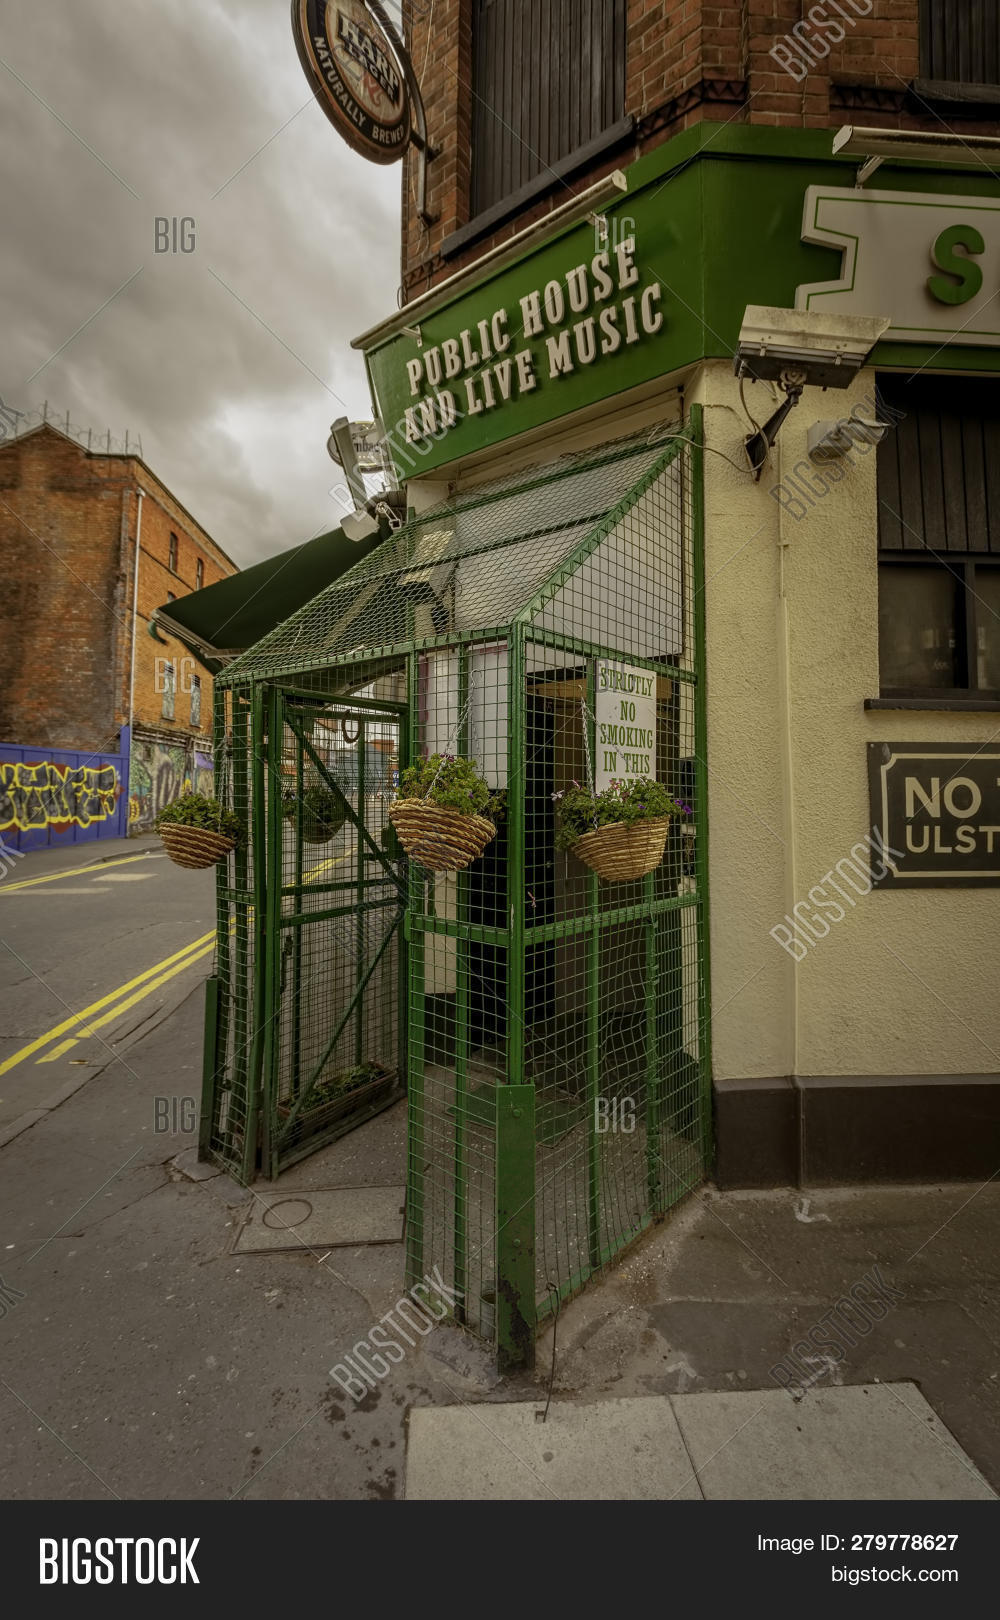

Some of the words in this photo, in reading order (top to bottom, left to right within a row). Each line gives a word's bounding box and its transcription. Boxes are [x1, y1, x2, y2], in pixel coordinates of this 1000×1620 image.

[340, 14, 399, 88] HARP
[313, 37, 366, 127] NATURALLY
[926, 224, 985, 306] S
[406, 308, 511, 396] PUBLIC
[519, 237, 639, 338] HOUSE
[404, 390, 457, 443] AND
[464, 349, 536, 415] LIVE
[545, 282, 663, 379] MUSIC
[600, 667, 653, 696] STRICTLY
[620, 700, 636, 722] NO
[600, 723, 653, 749] SMOKING
[603, 751, 617, 772] IN
[624, 753, 650, 774] THIS
[905, 777, 982, 818] NO
[906, 825, 1000, 854] ULST
